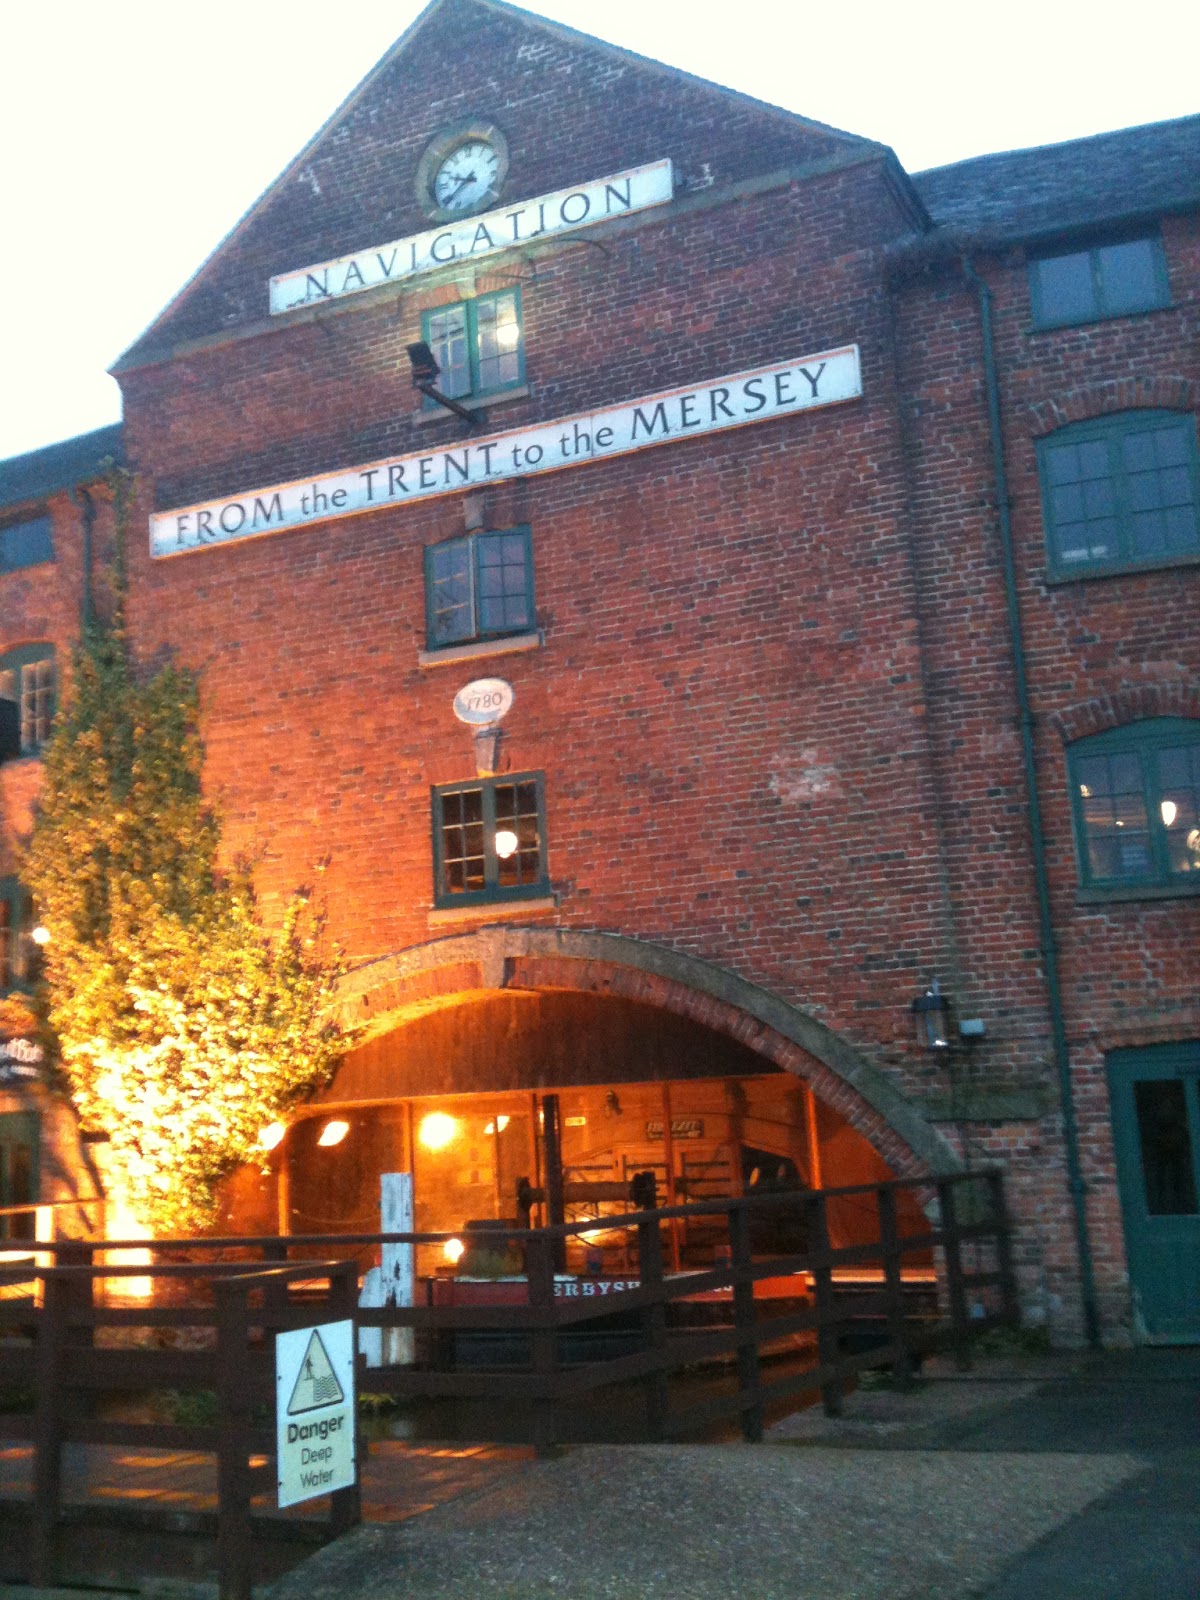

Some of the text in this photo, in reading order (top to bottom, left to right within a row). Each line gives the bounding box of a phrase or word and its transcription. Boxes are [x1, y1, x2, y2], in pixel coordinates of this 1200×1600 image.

[305, 177, 633, 297] NAVIGATION
[175, 362, 827, 545] FROM the TRENT to the MERSEY
[467, 692, 503, 711] 1780
[287, 1415, 344, 1443] Danger
[301, 1446, 332, 1466] Deep
[300, 1469, 334, 1488] Water
